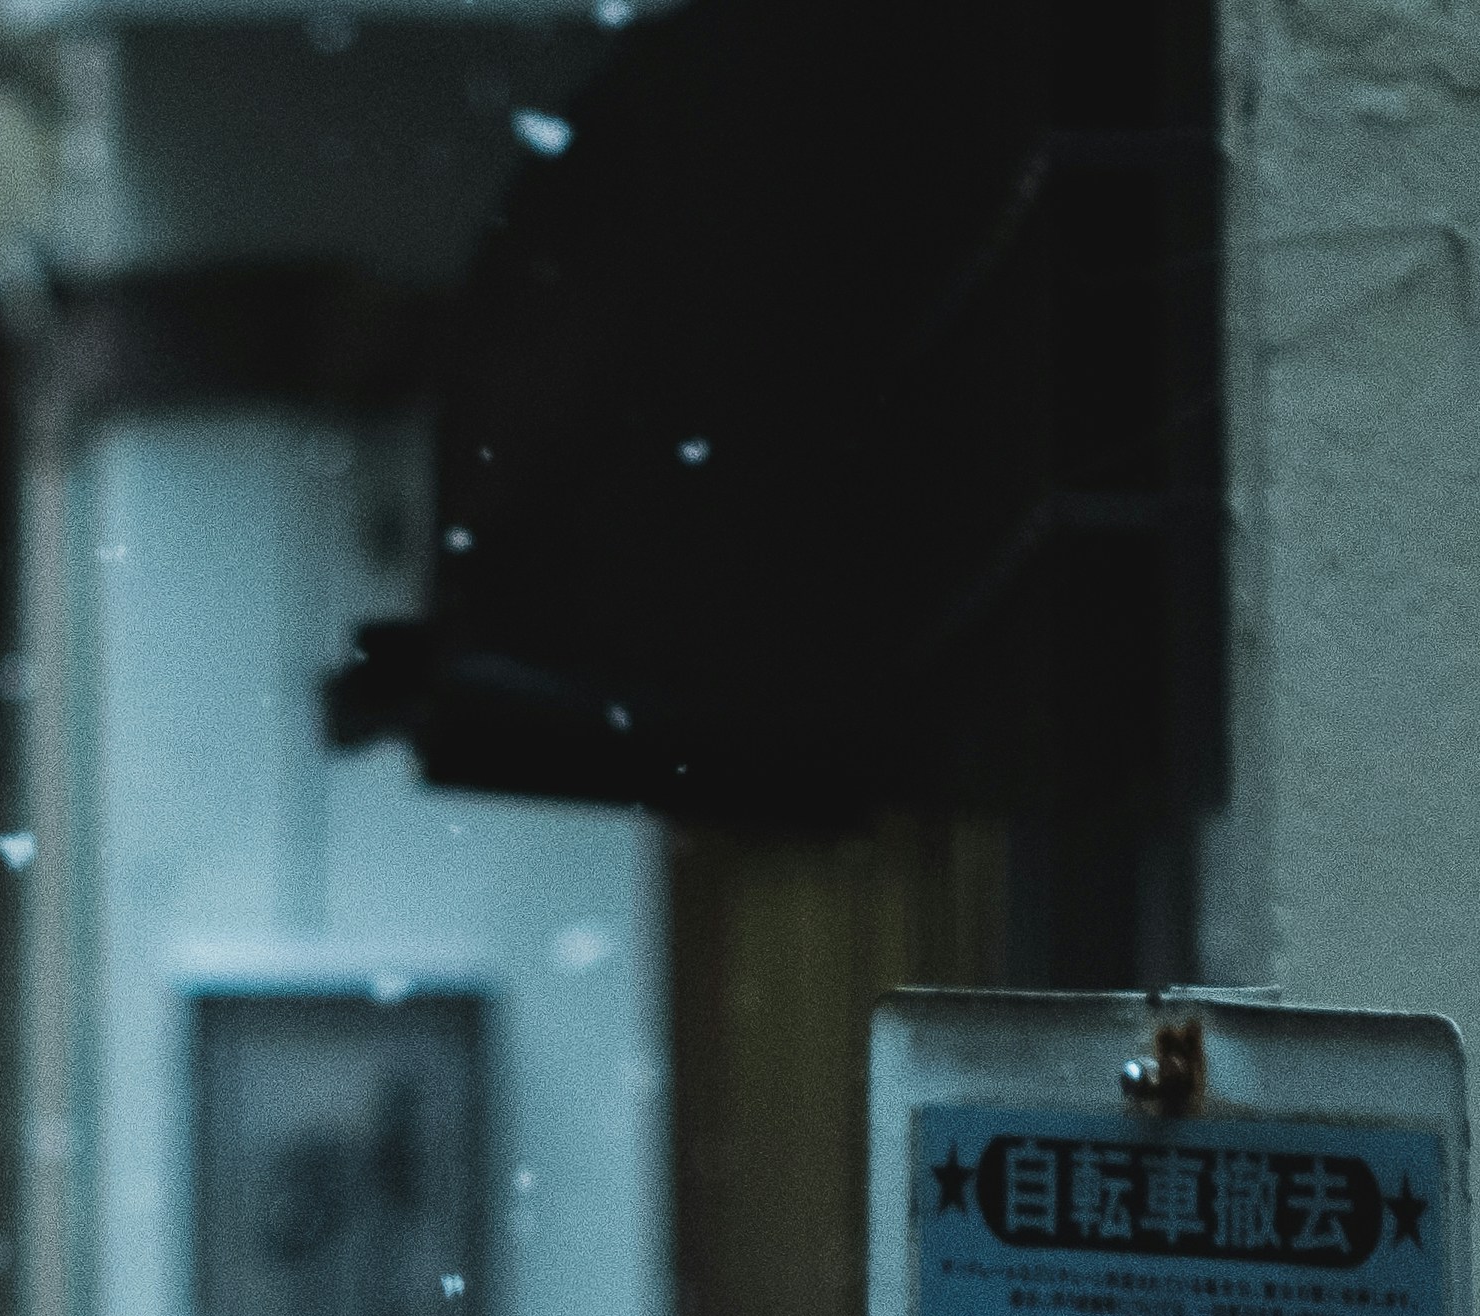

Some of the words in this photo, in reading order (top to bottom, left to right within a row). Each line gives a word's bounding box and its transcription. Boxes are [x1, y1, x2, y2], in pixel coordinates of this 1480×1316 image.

[1004, 1142, 1355, 1254] 自転車撤去
